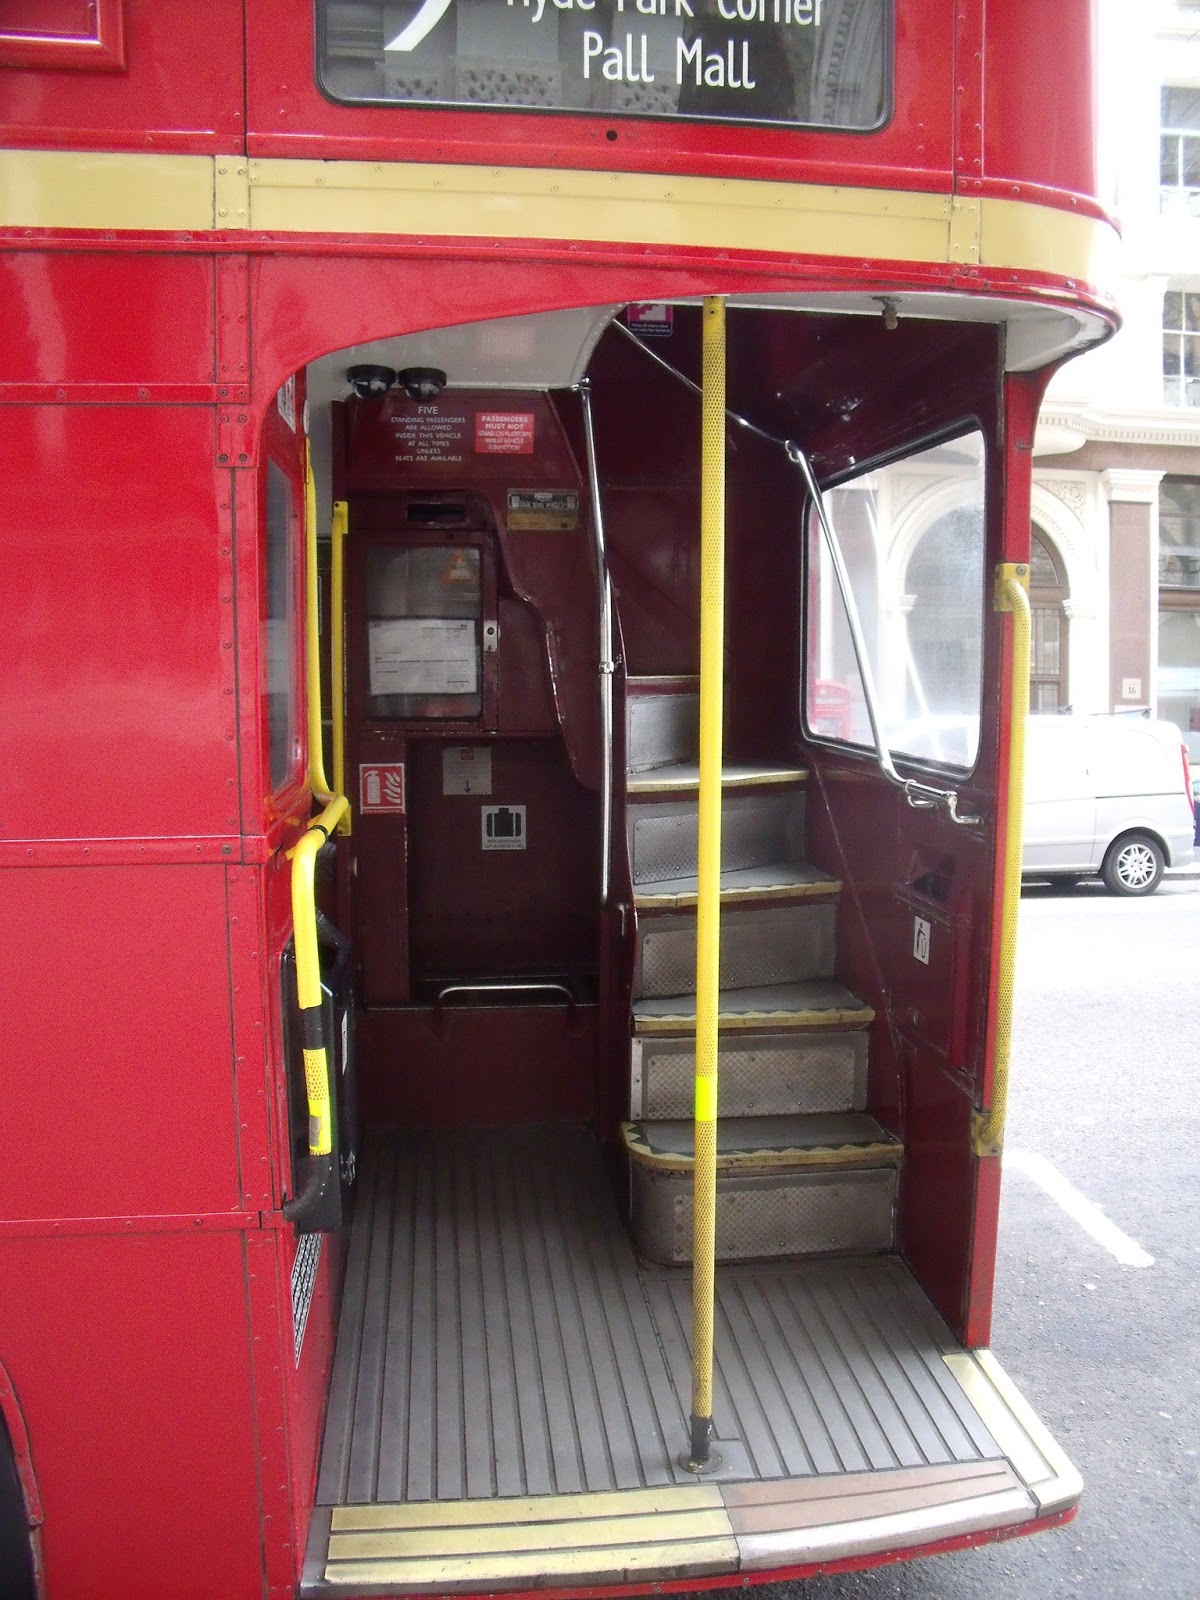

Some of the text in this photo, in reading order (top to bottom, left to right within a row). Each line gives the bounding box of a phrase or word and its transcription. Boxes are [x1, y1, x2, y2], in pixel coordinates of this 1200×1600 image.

[583, 31, 756, 90] Pall Mall
[418, 406, 438, 415] FIVE
[481, 415, 528, 423] PASSENGERS
[1128, 686, 1136, 694] 16
